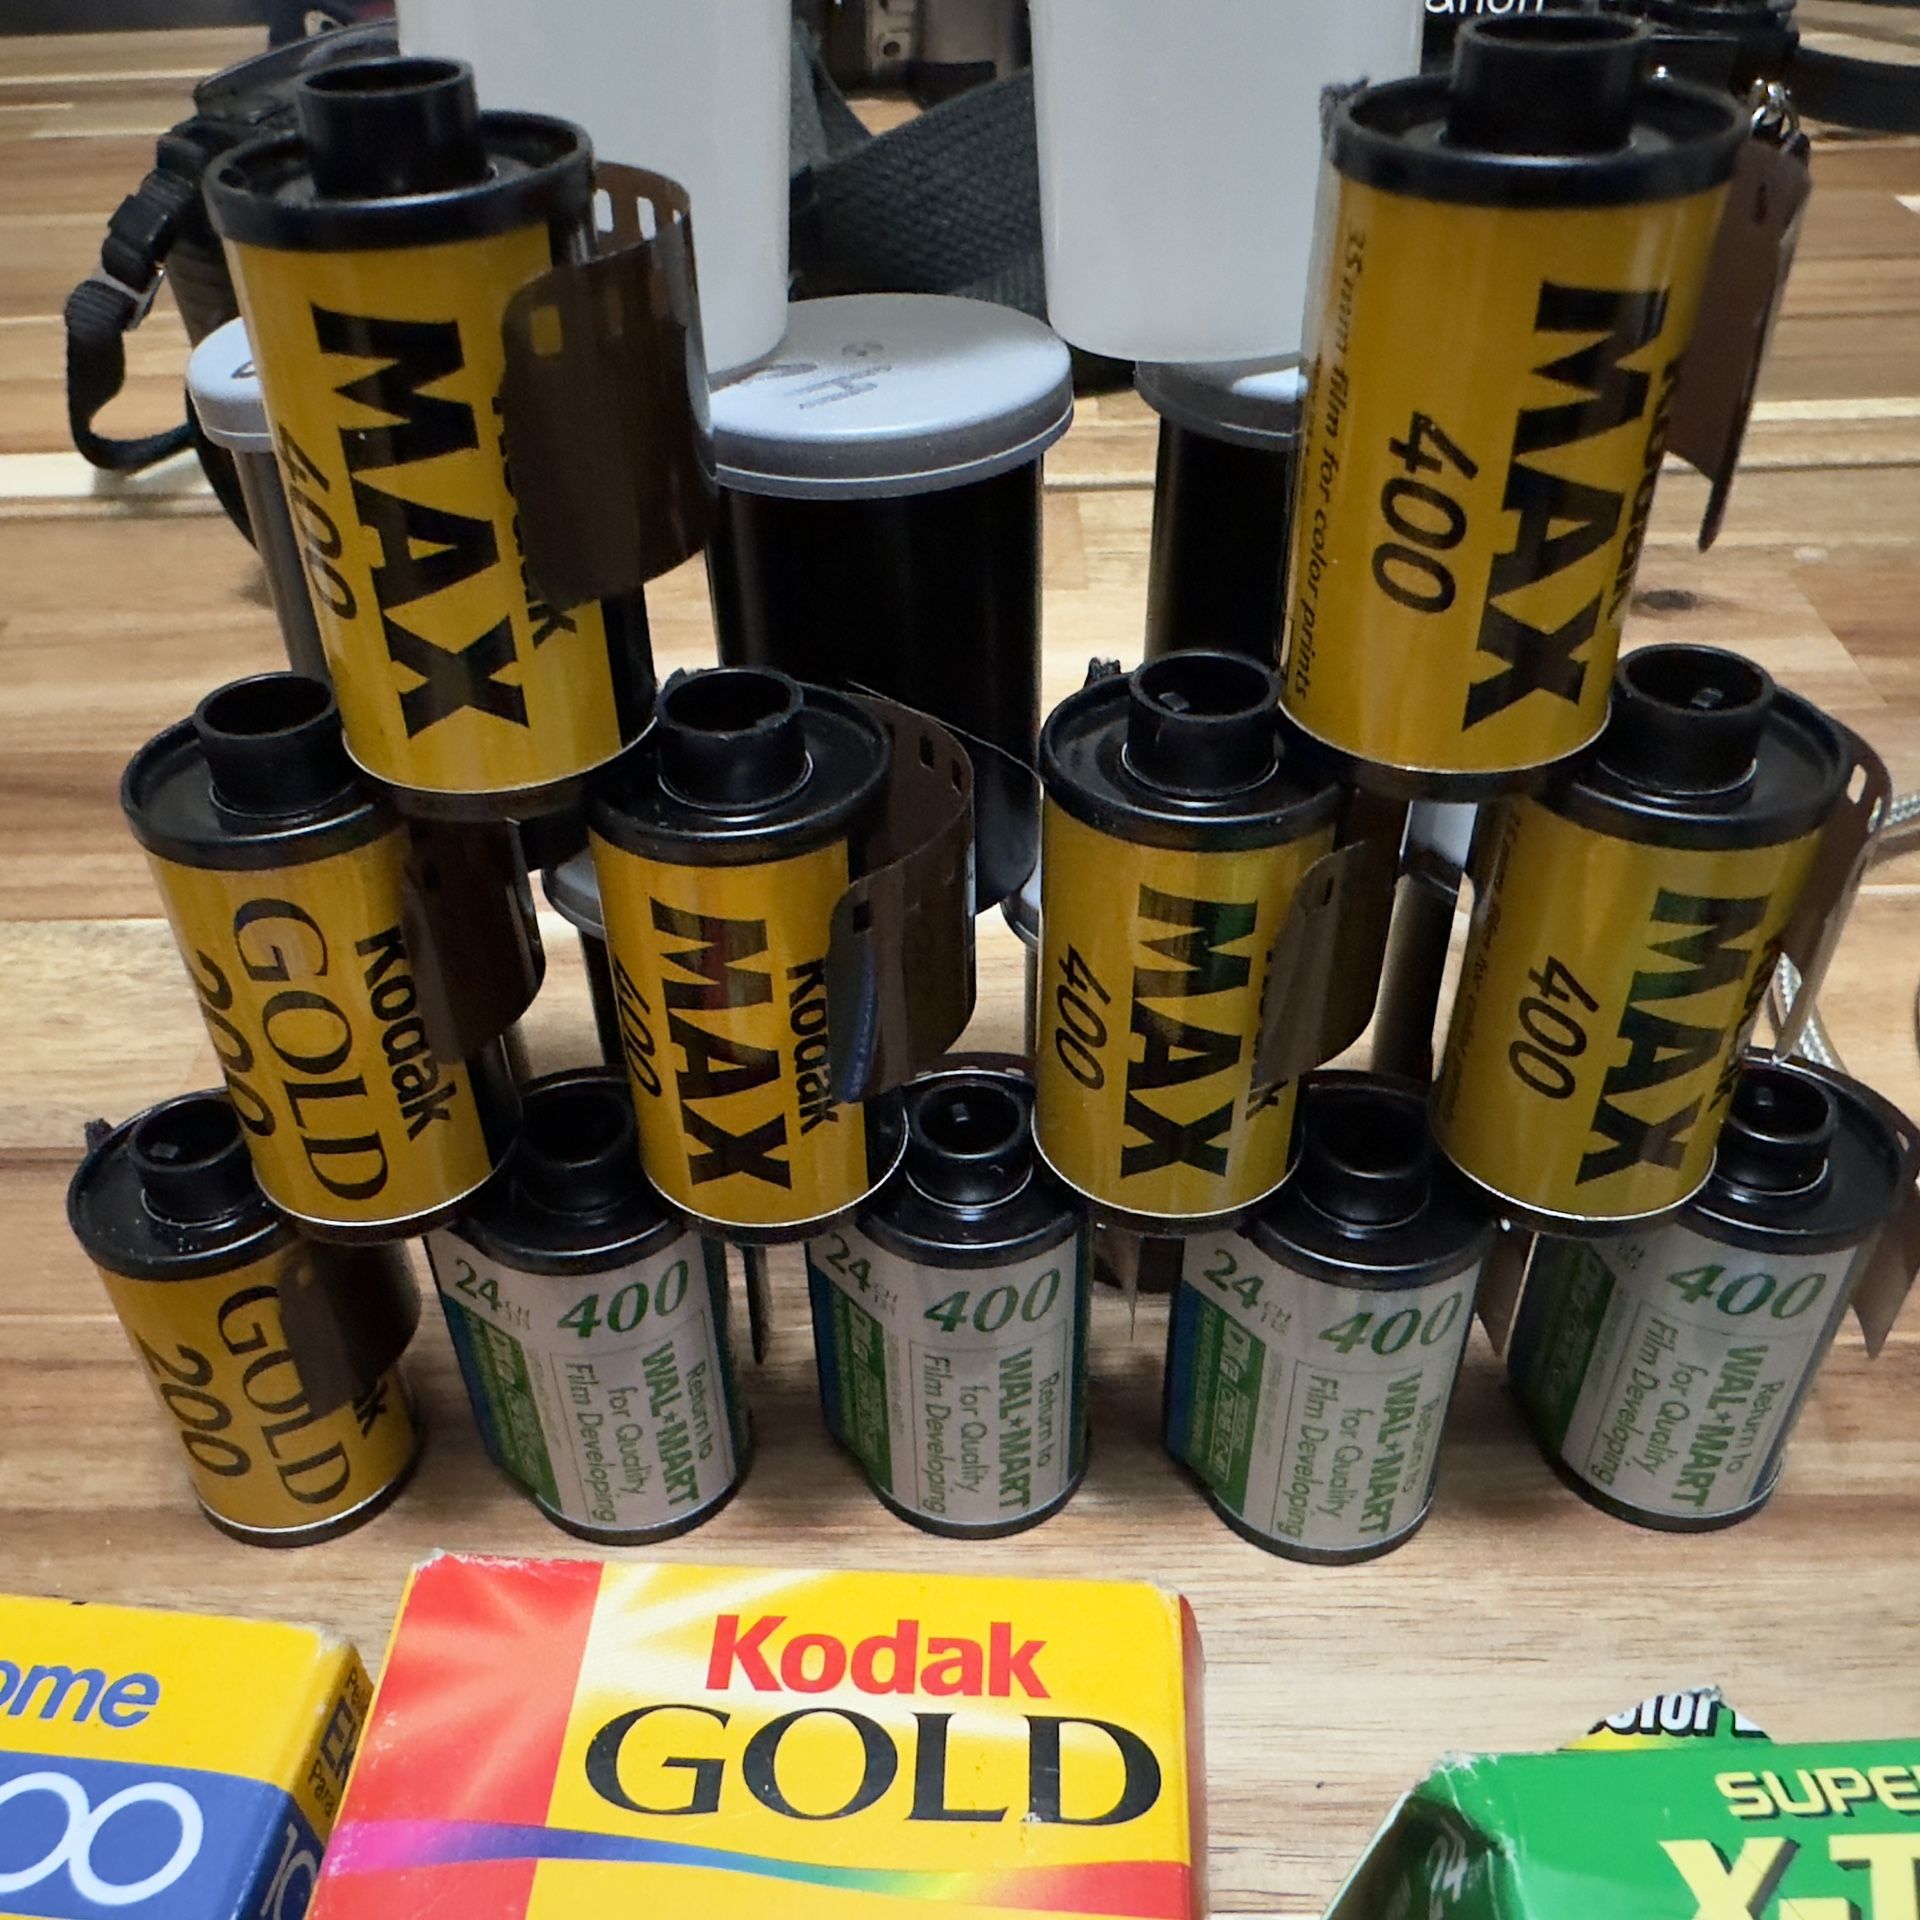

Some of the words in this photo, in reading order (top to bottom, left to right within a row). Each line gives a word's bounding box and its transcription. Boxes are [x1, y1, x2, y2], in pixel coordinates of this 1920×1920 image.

[1424, 0, 1543, 14] anon
[1325, 364, 1349, 438] film
[1319, 448, 1340, 503] for
[1372, 411, 1479, 616] 400
[1461, 279, 1669, 732] MAX
[278, 422, 358, 622] 400
[310, 303, 530, 739] MAX
[1307, 508, 1328, 598] color
[1296, 598, 1316, 699] prints
[234, 898, 388, 1200] GOLD
[355, 926, 457, 1142] Kodak
[650, 896, 792, 1190] MAX
[1055, 943, 1111, 1090] 400
[1121, 884, 1258, 1179] MAX
[1508, 955, 1600, 1100] 400
[1575, 886, 1774, 1187] MAX
[456, 1258, 503, 1312] 24
[557, 1260, 688, 1338] 400
[826, 1233, 872, 1293] 24
[924, 1268, 1061, 1333] 400
[1203, 1249, 1264, 1310] 24
[1666, 1264, 1827, 1320] 400
[1319, 1291, 1463, 1355] 400
[1640, 1317, 1679, 1365] Film
[135, 1331, 251, 1477] 200
[566, 1363, 599, 1407] Film
[608, 1387, 638, 1418] for
[923, 1354, 953, 1398] Film
[959, 1385, 991, 1414] for
[1301, 1374, 1338, 1421] Film
[1669, 1361, 1708, 1396] for
[616, 1423, 652, 1495] Quality
[921, 1404, 954, 1514] Developing
[955, 1422, 991, 1494] Quality
[1339, 1407, 1375, 1437] for
[1591, 1368, 1659, 1487] Developing
[1642, 1401, 1690, 1477] Quality
[577, 1412, 618, 1523] Developing
[1277, 1424, 1329, 1538] Developing
[1317, 1442, 1364, 1518] Quality
[705, 1614, 1051, 1699] Kodak
[585, 1704, 1162, 1826] GOLD
[1715, 1765, 1920, 1819] SUPE
